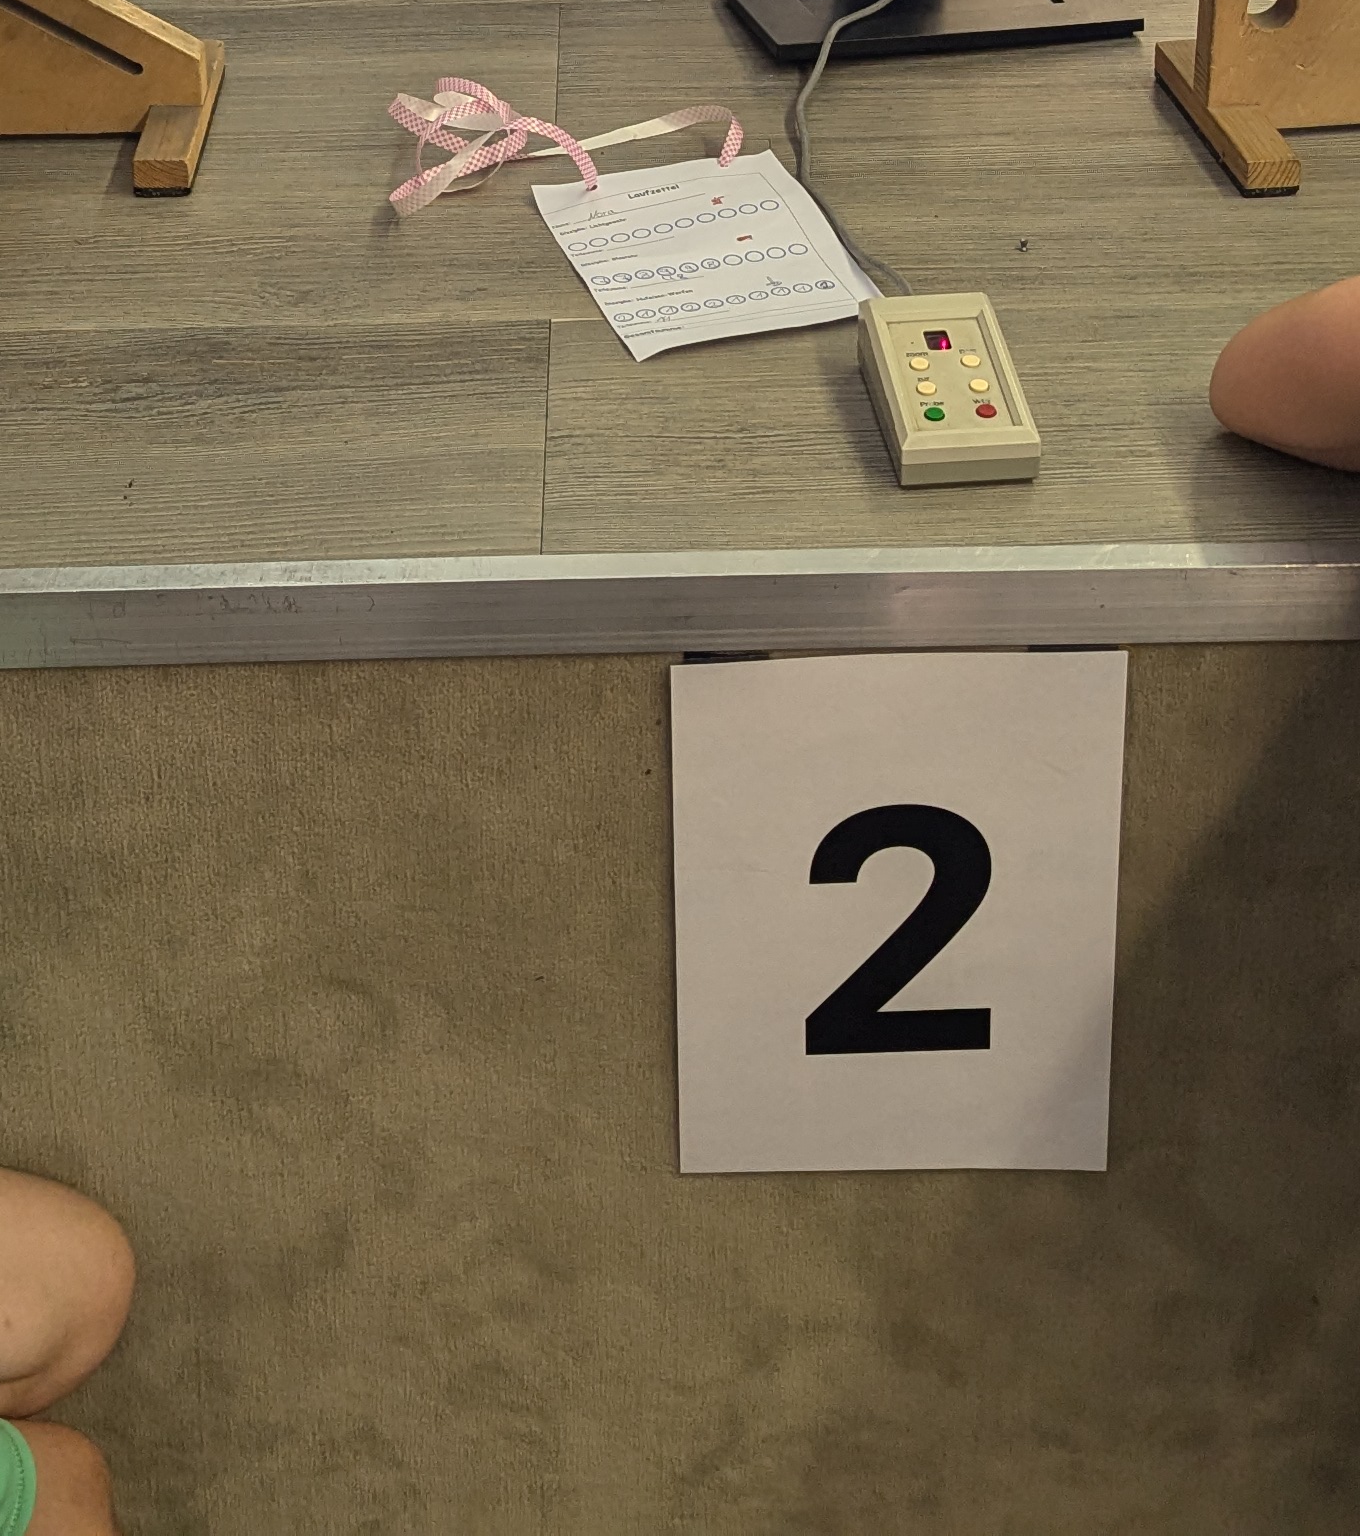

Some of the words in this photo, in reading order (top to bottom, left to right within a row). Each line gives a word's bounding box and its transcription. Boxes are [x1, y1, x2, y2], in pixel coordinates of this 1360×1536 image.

[627, 183, 680, 200] Laufzettel
[588, 208, 618, 222] Nora
[805, 803, 993, 1056] 2
